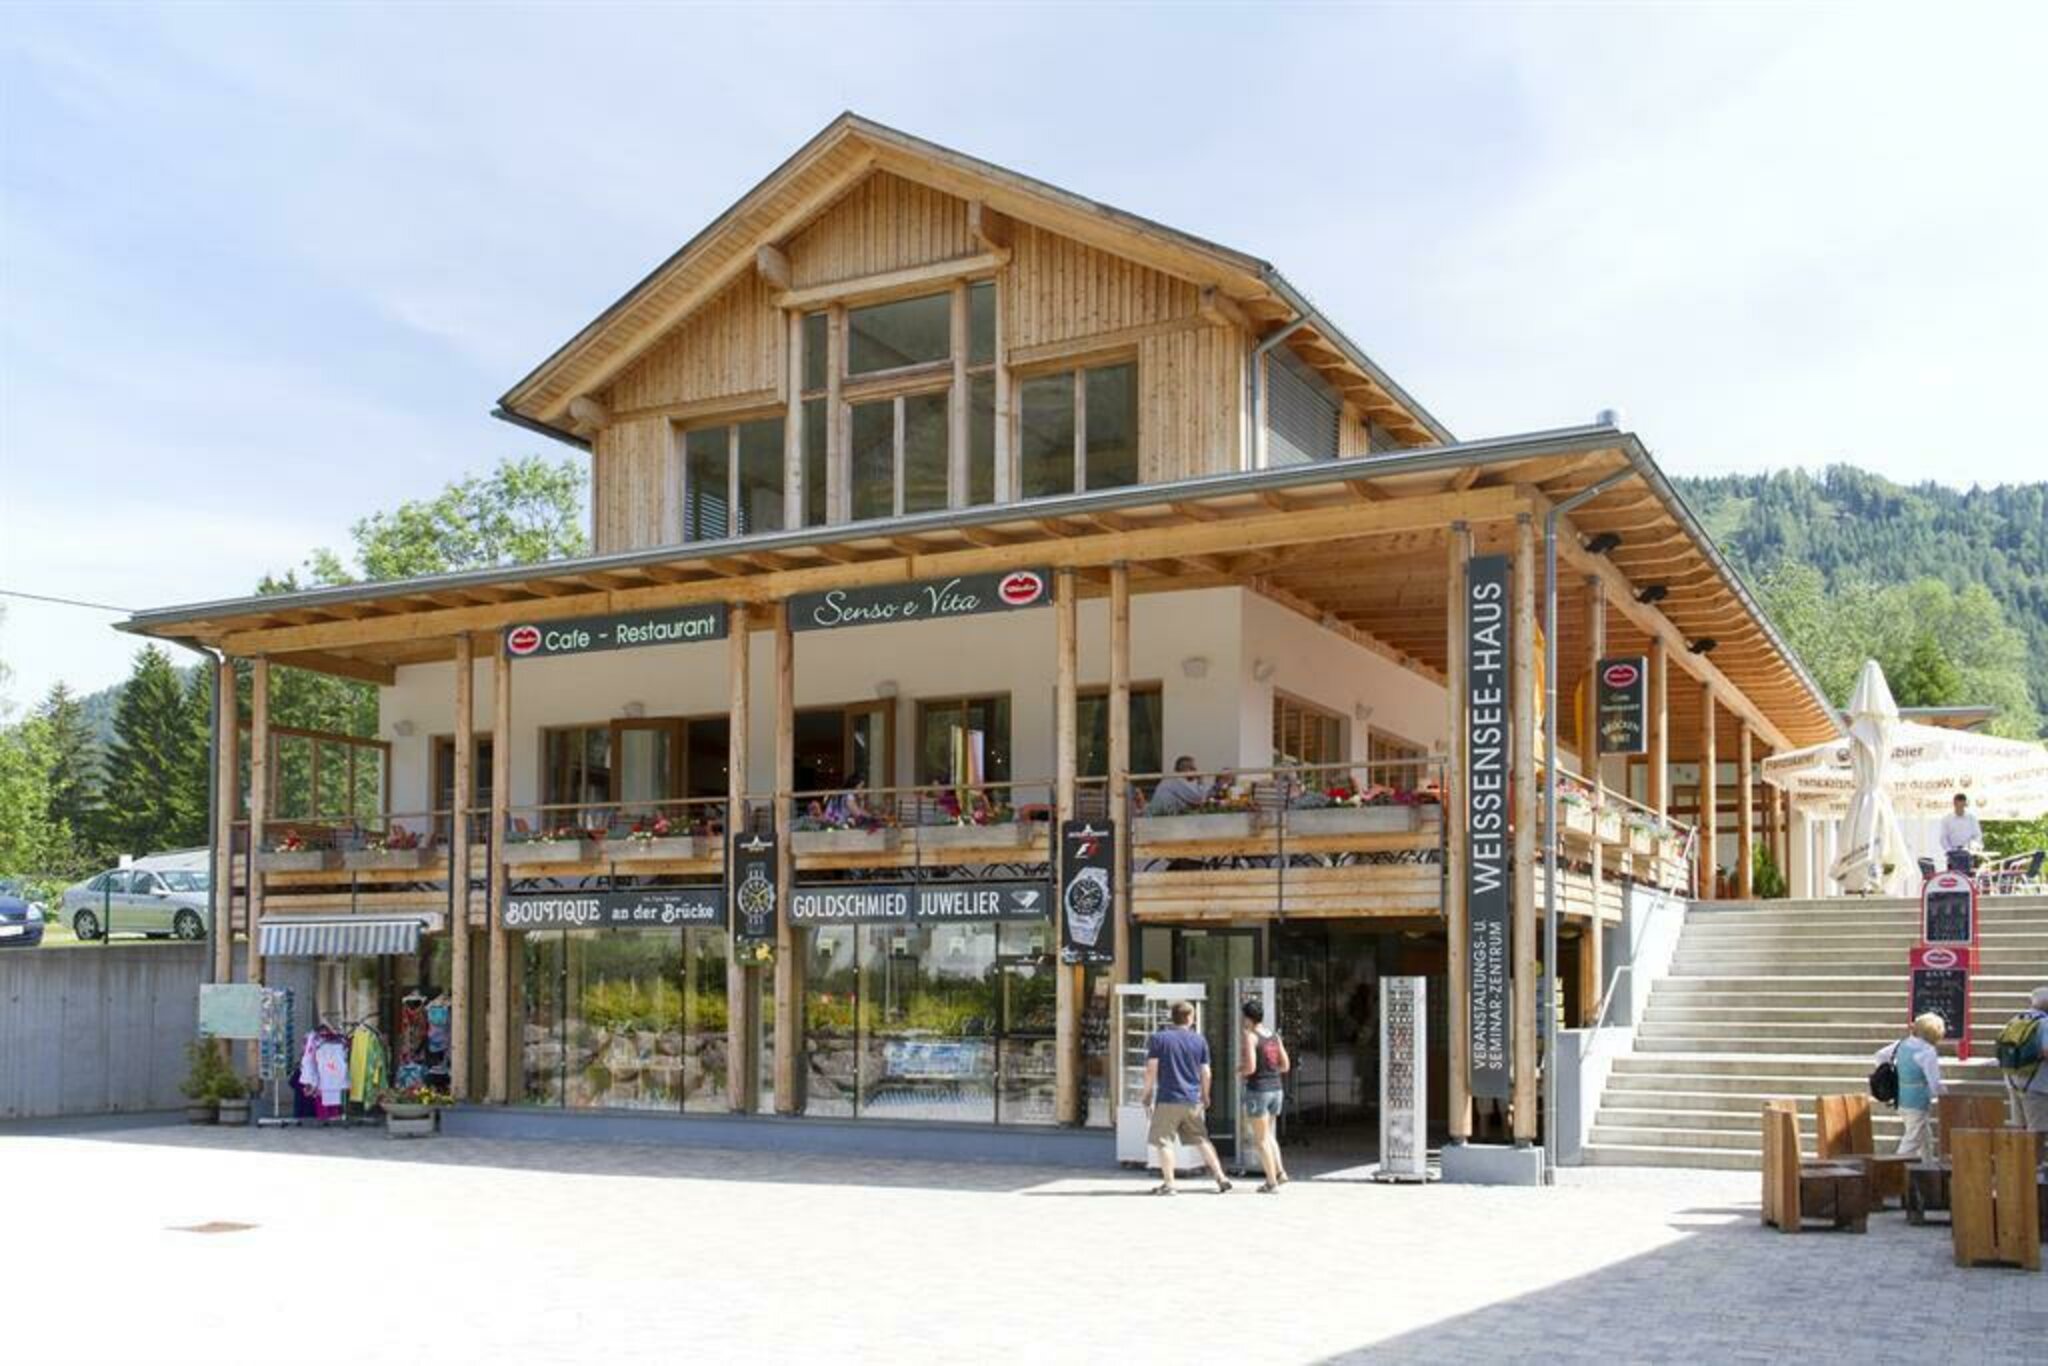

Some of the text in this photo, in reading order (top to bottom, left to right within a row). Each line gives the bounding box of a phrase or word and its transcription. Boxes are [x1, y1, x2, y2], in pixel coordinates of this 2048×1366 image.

[814, 578, 980, 626] Senso e Vita
[545, 629, 590, 651] Cafe
[616, 615, 716, 644] Restaurant
[1473, 582, 1501, 895] WEISSENSEE-HAUS
[505, 899, 714, 925] BOUTIQUE an der Brücke
[793, 891, 1000, 918] GOLDSCHMIED JUWELIER
[1473, 934, 1487, 1070] VERANSTALTUNGS-
[1489, 921, 1503, 1070] SEMINAR-ZENTRUM
